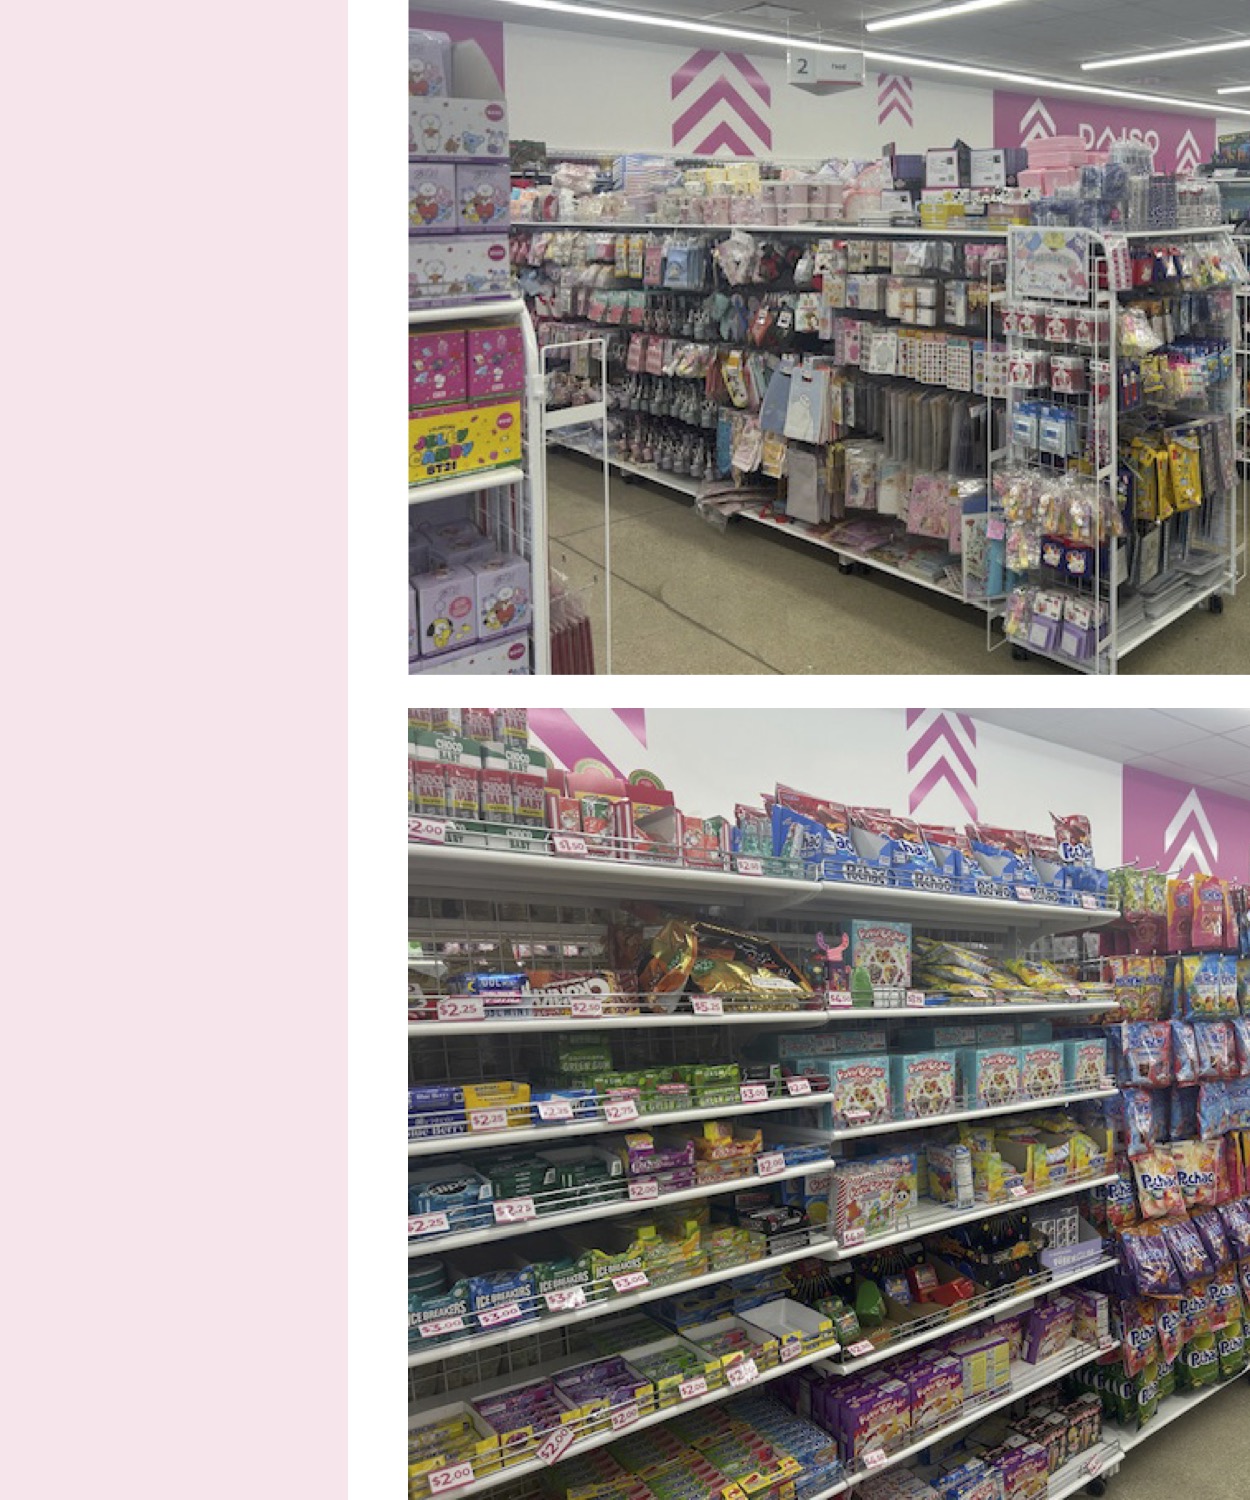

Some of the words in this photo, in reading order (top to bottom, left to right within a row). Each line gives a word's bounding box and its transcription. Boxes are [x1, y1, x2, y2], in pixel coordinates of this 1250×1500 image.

[797, 59, 808, 74] 2
[435, 739, 463, 752] CHOCO
[505, 750, 530, 762] CHOCO
[439, 1004, 477, 1016] $2.25
[572, 1002, 600, 1012] $2.50
[472, 1114, 504, 1126] $2.25
[630, 1186, 657, 1197] $2.00
[615, 1274, 645, 1289] $3.00
[422, 1300, 467, 1322] BREAKERS
[681, 1381, 706, 1394] $2.00
[612, 1408, 638, 1423] $2.00
[541, 1427, 569, 1460] $2.00
[431, 1468, 470, 1486] $2.00
